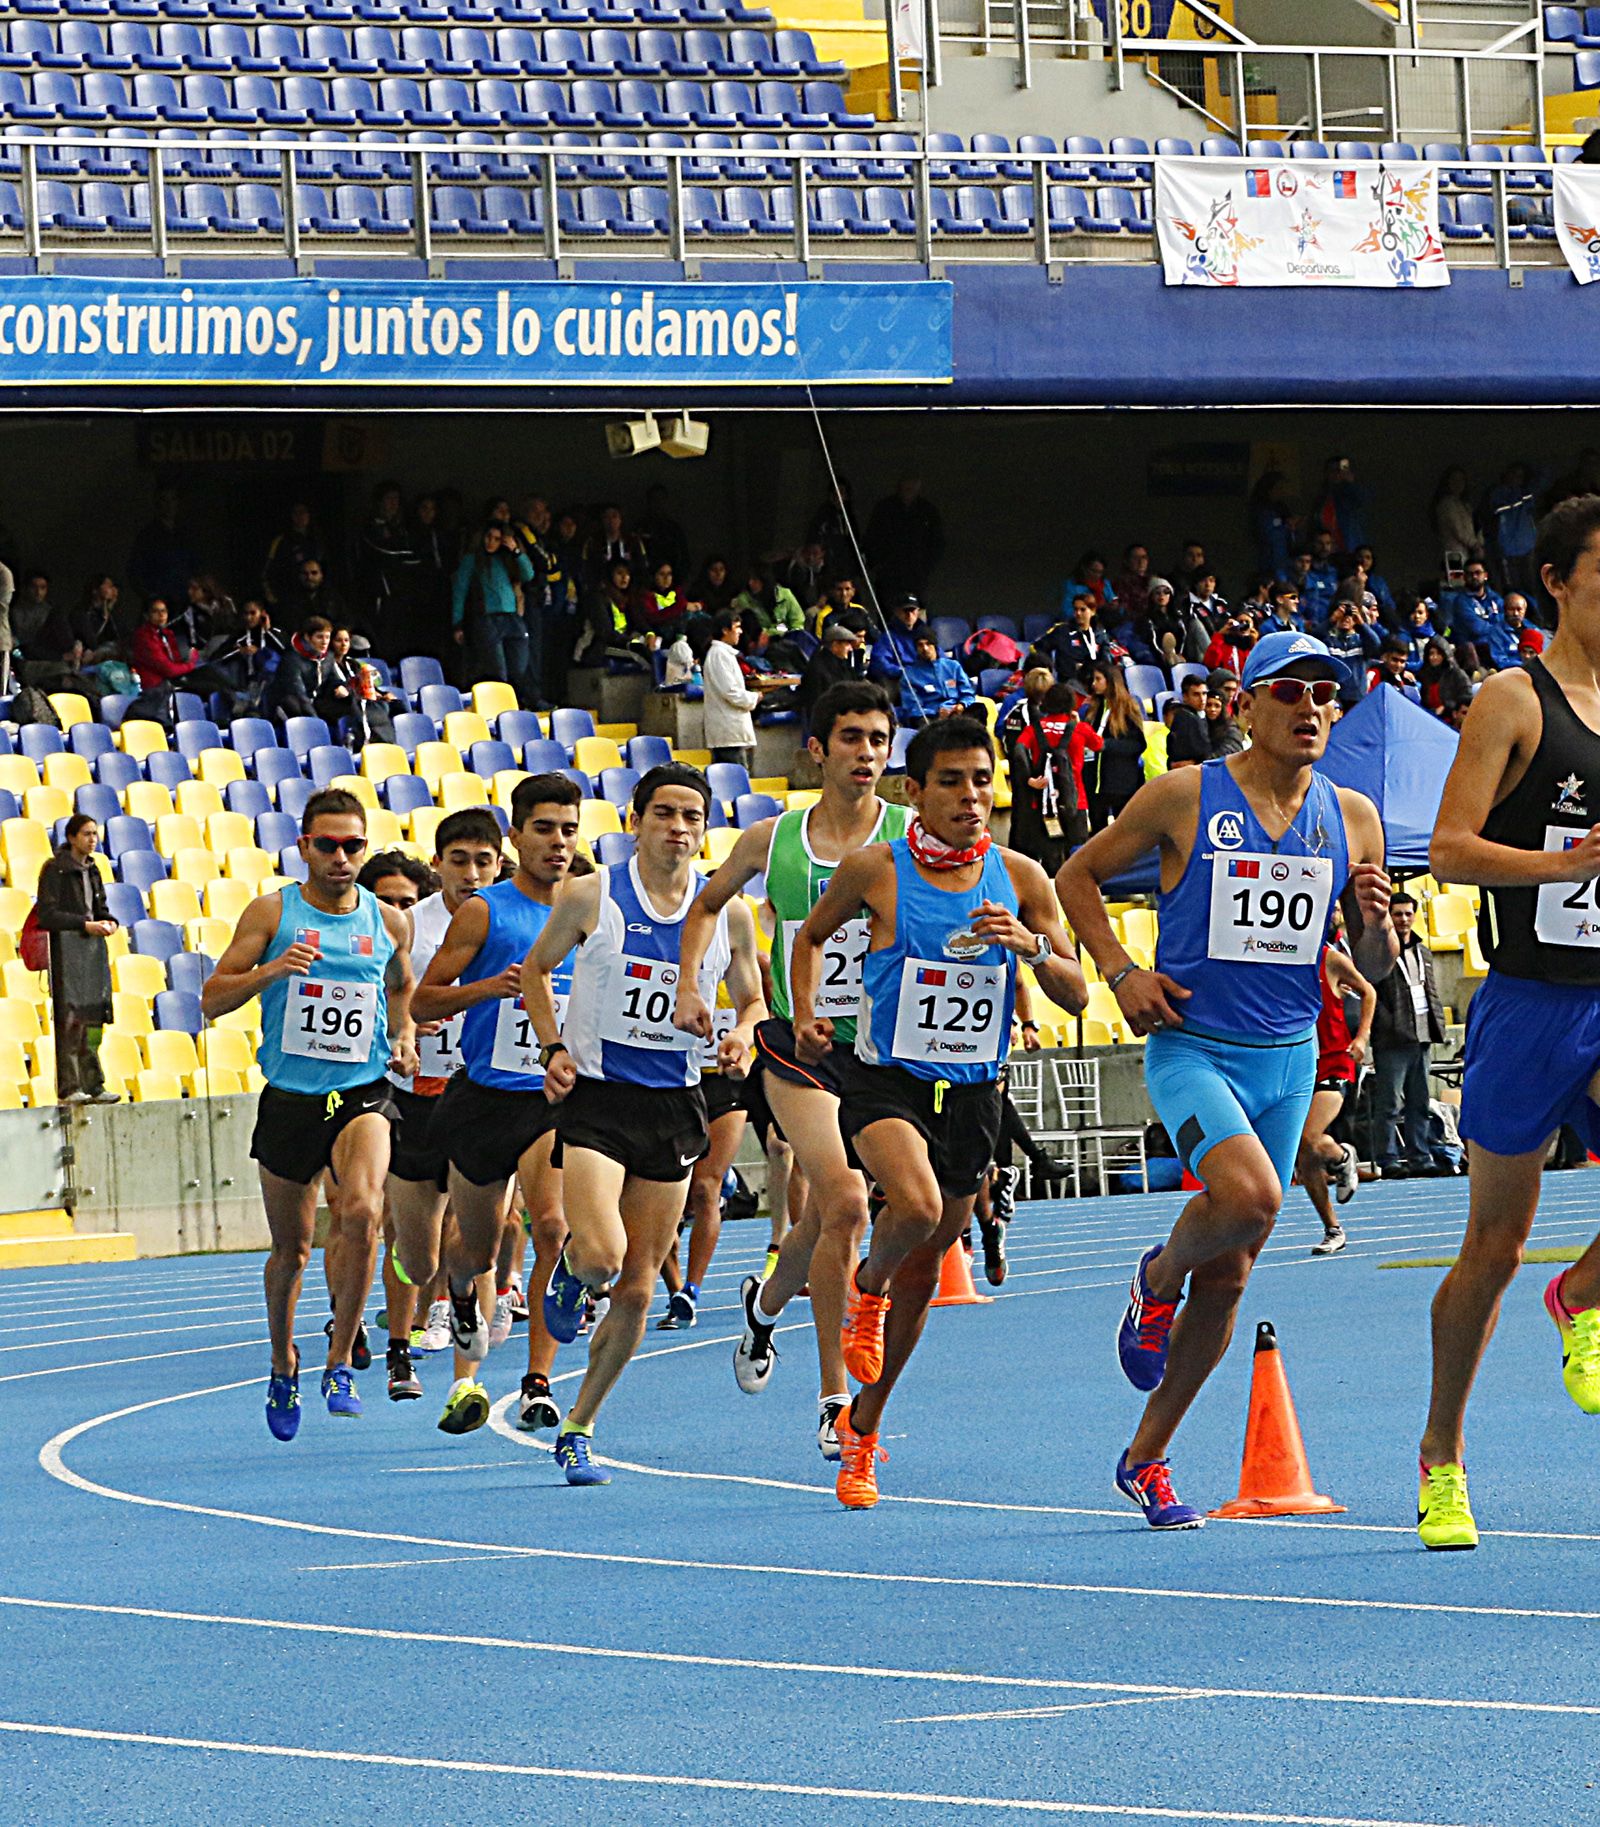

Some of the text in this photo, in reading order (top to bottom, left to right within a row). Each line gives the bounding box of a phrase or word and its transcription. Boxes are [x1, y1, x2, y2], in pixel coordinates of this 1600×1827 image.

[0, 288, 798, 372] construimos, juntos lo cuidamos!
[149, 429, 295, 461] SALIDA 02
[1233, 888, 1314, 932] 190
[1256, 940, 1298, 953] Deportivos
[300, 1004, 363, 1038] 196
[918, 995, 993, 1033] 129
[939, 1042, 978, 1053] Deportivos
